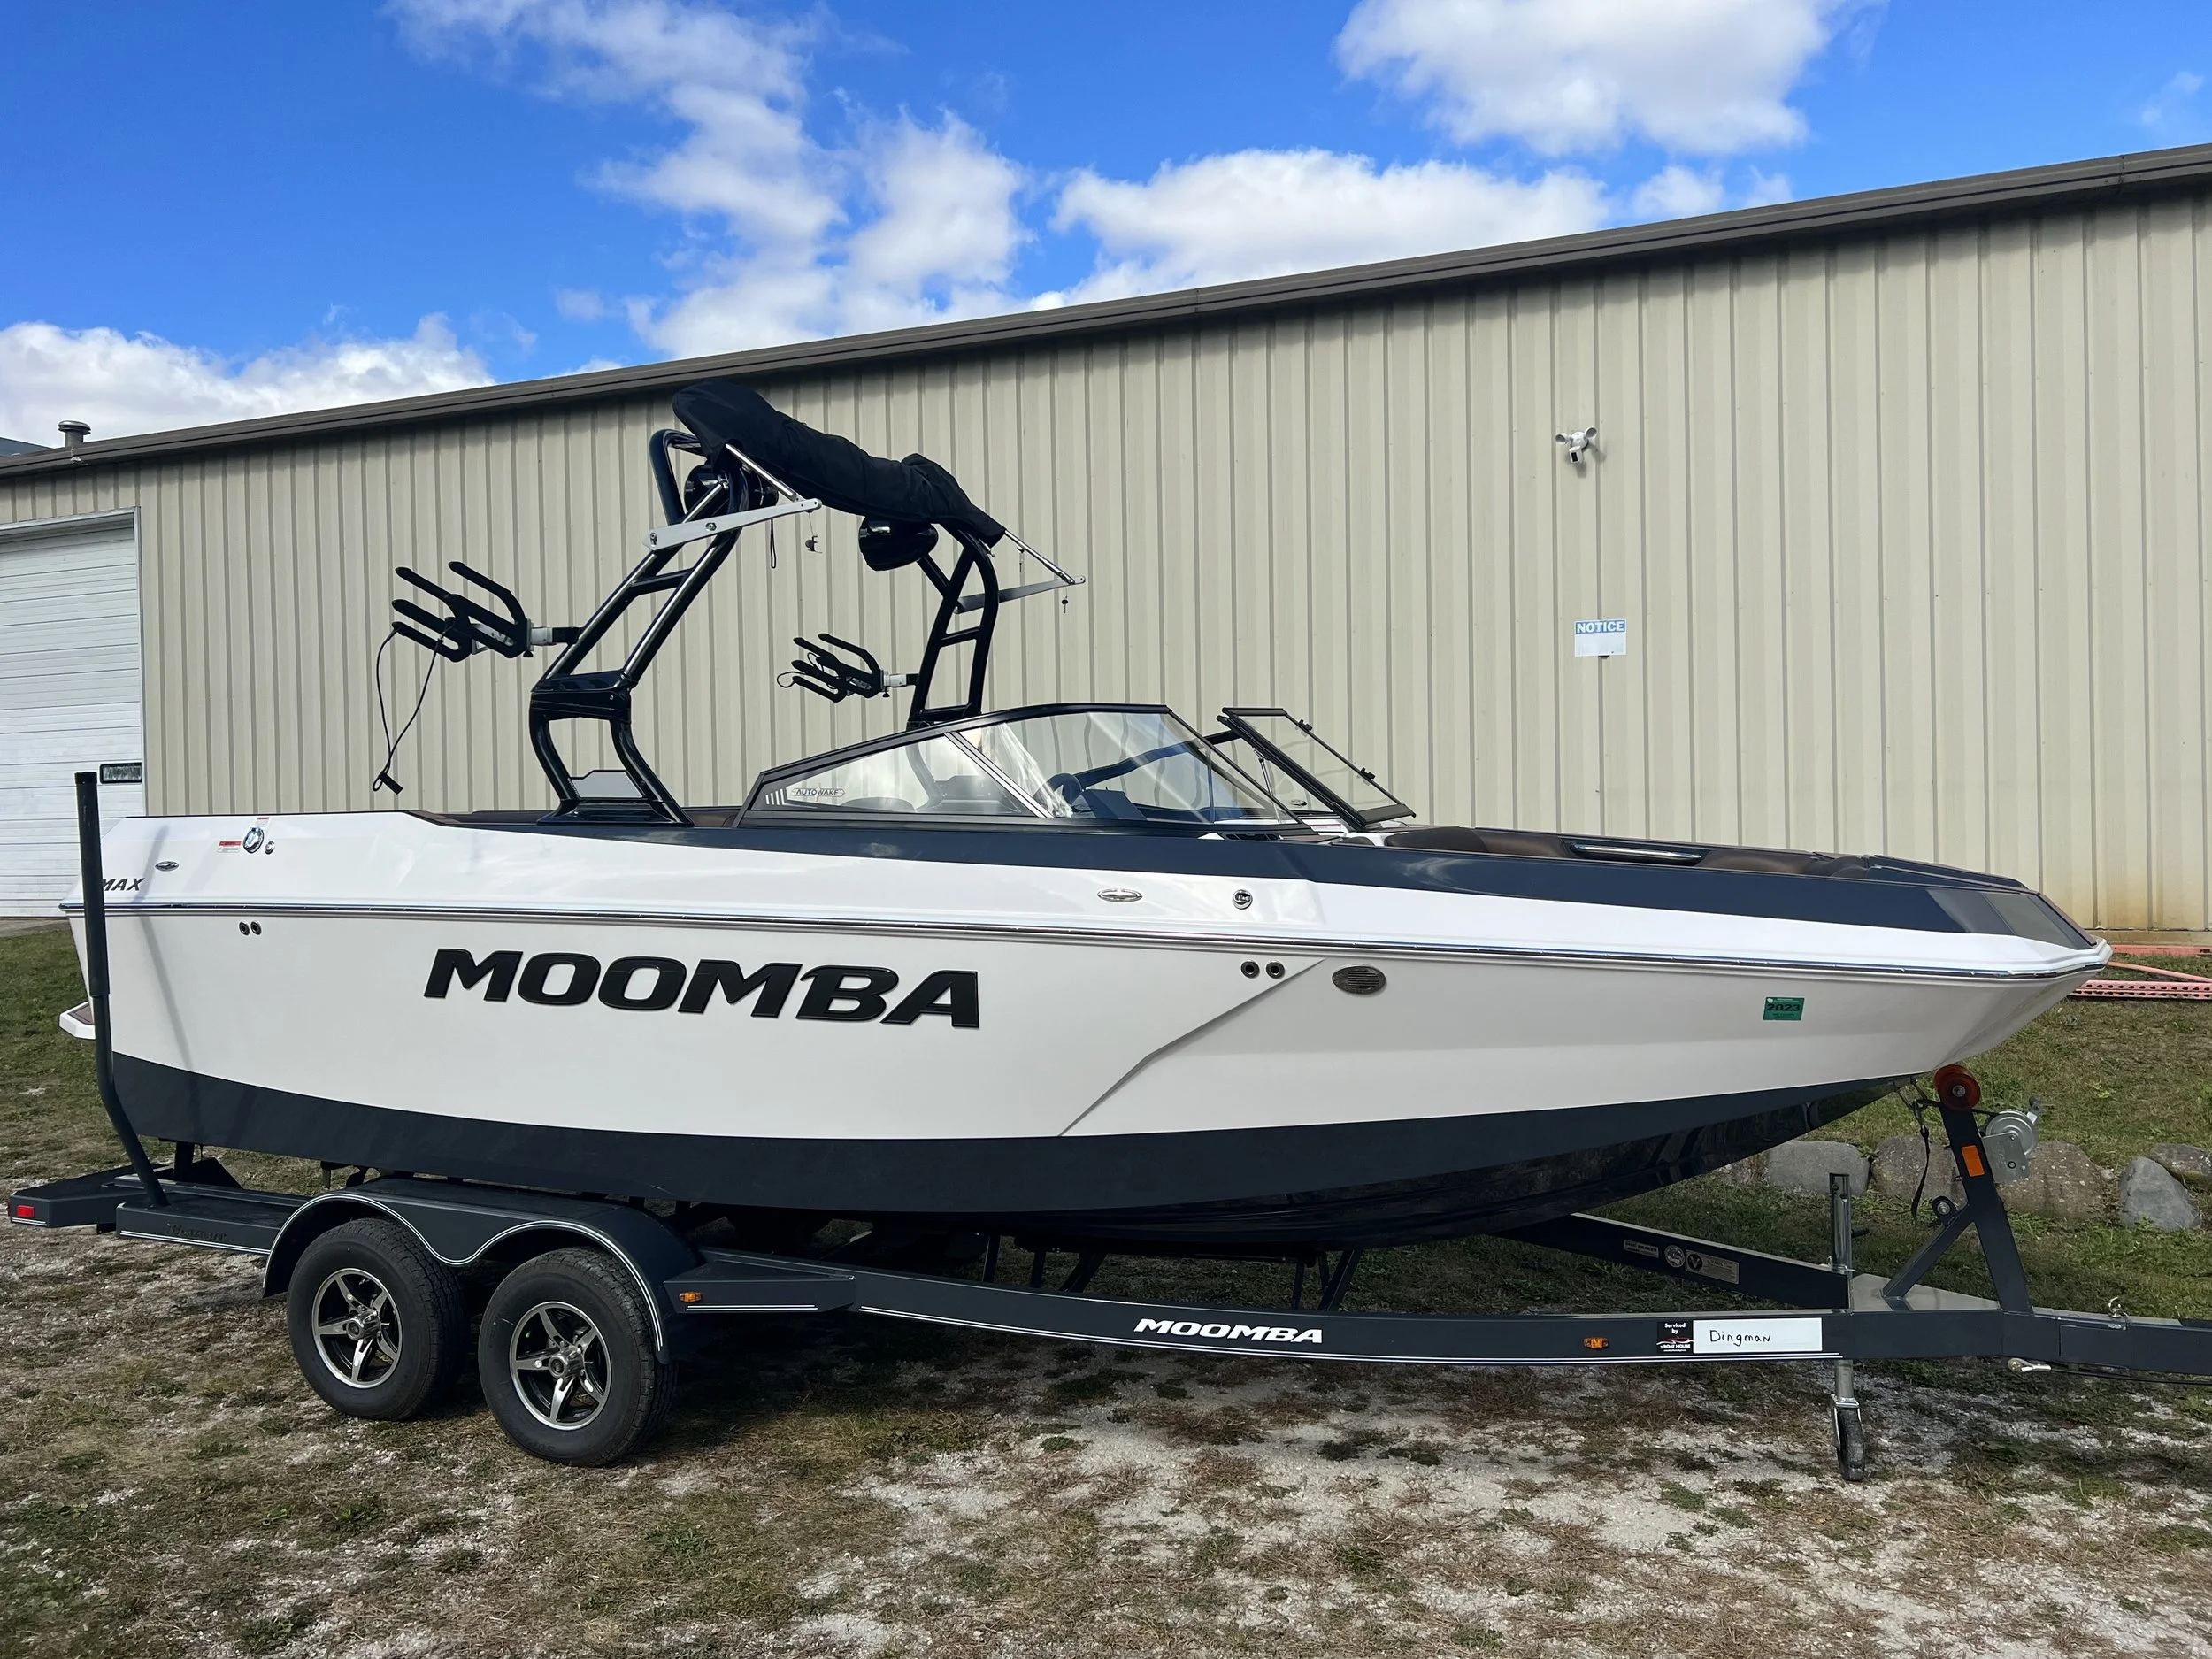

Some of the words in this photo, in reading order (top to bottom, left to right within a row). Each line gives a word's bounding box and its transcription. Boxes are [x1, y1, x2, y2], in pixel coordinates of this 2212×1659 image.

[1577, 621, 1624, 633] NOTICE
[423, 948, 980, 1029] MOOMBA
[1133, 1318, 1324, 1344] MOOMBA
